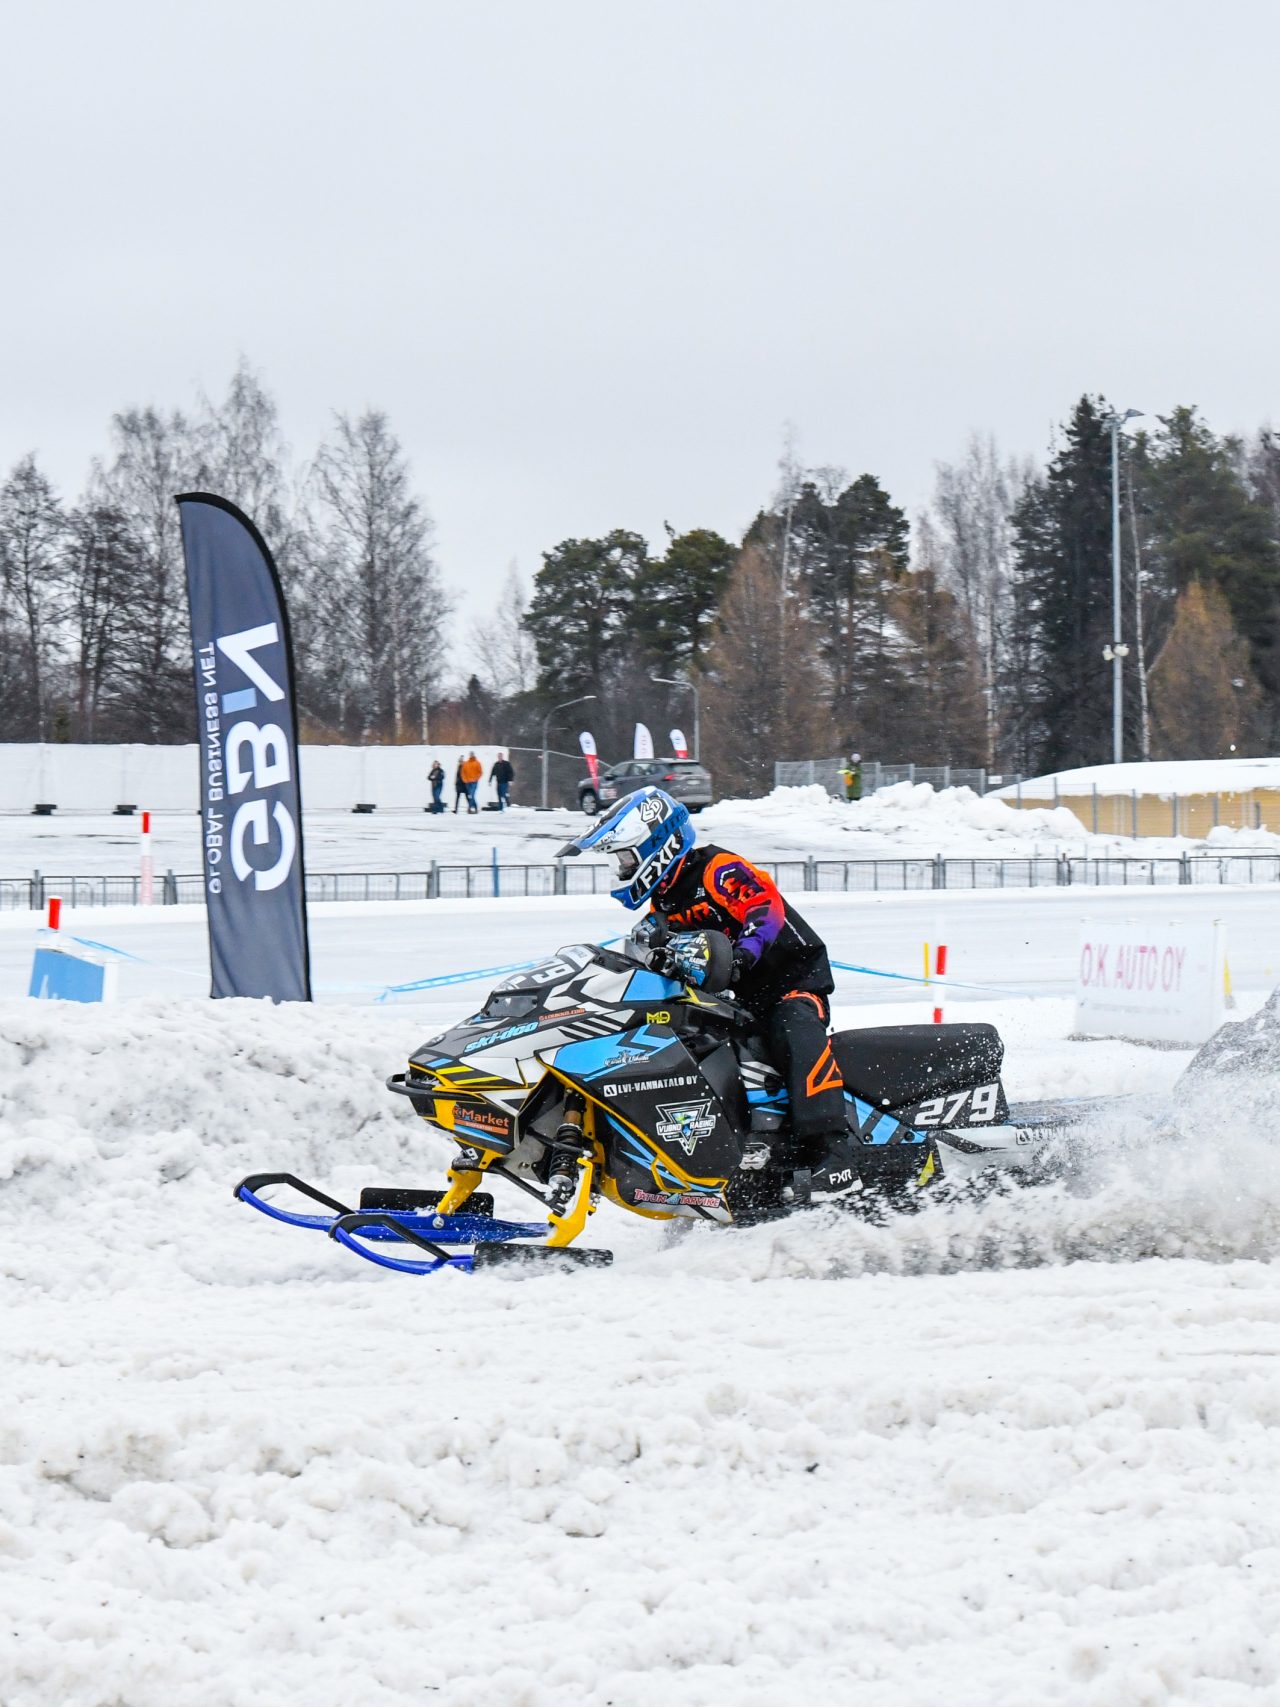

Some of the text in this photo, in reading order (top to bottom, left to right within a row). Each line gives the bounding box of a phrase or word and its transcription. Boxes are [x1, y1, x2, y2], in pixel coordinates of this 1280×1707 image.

[640, 834, 681, 890] FXR
[1114, 944, 1158, 990] AUTO
[1162, 946, 1186, 991] OY
[618, 1075, 698, 1094] LVI-VANHATALO OY
[914, 1083, 999, 1126] 279
[690, 1119, 714, 1129] RACING
[829, 1169, 852, 1185] FXR
